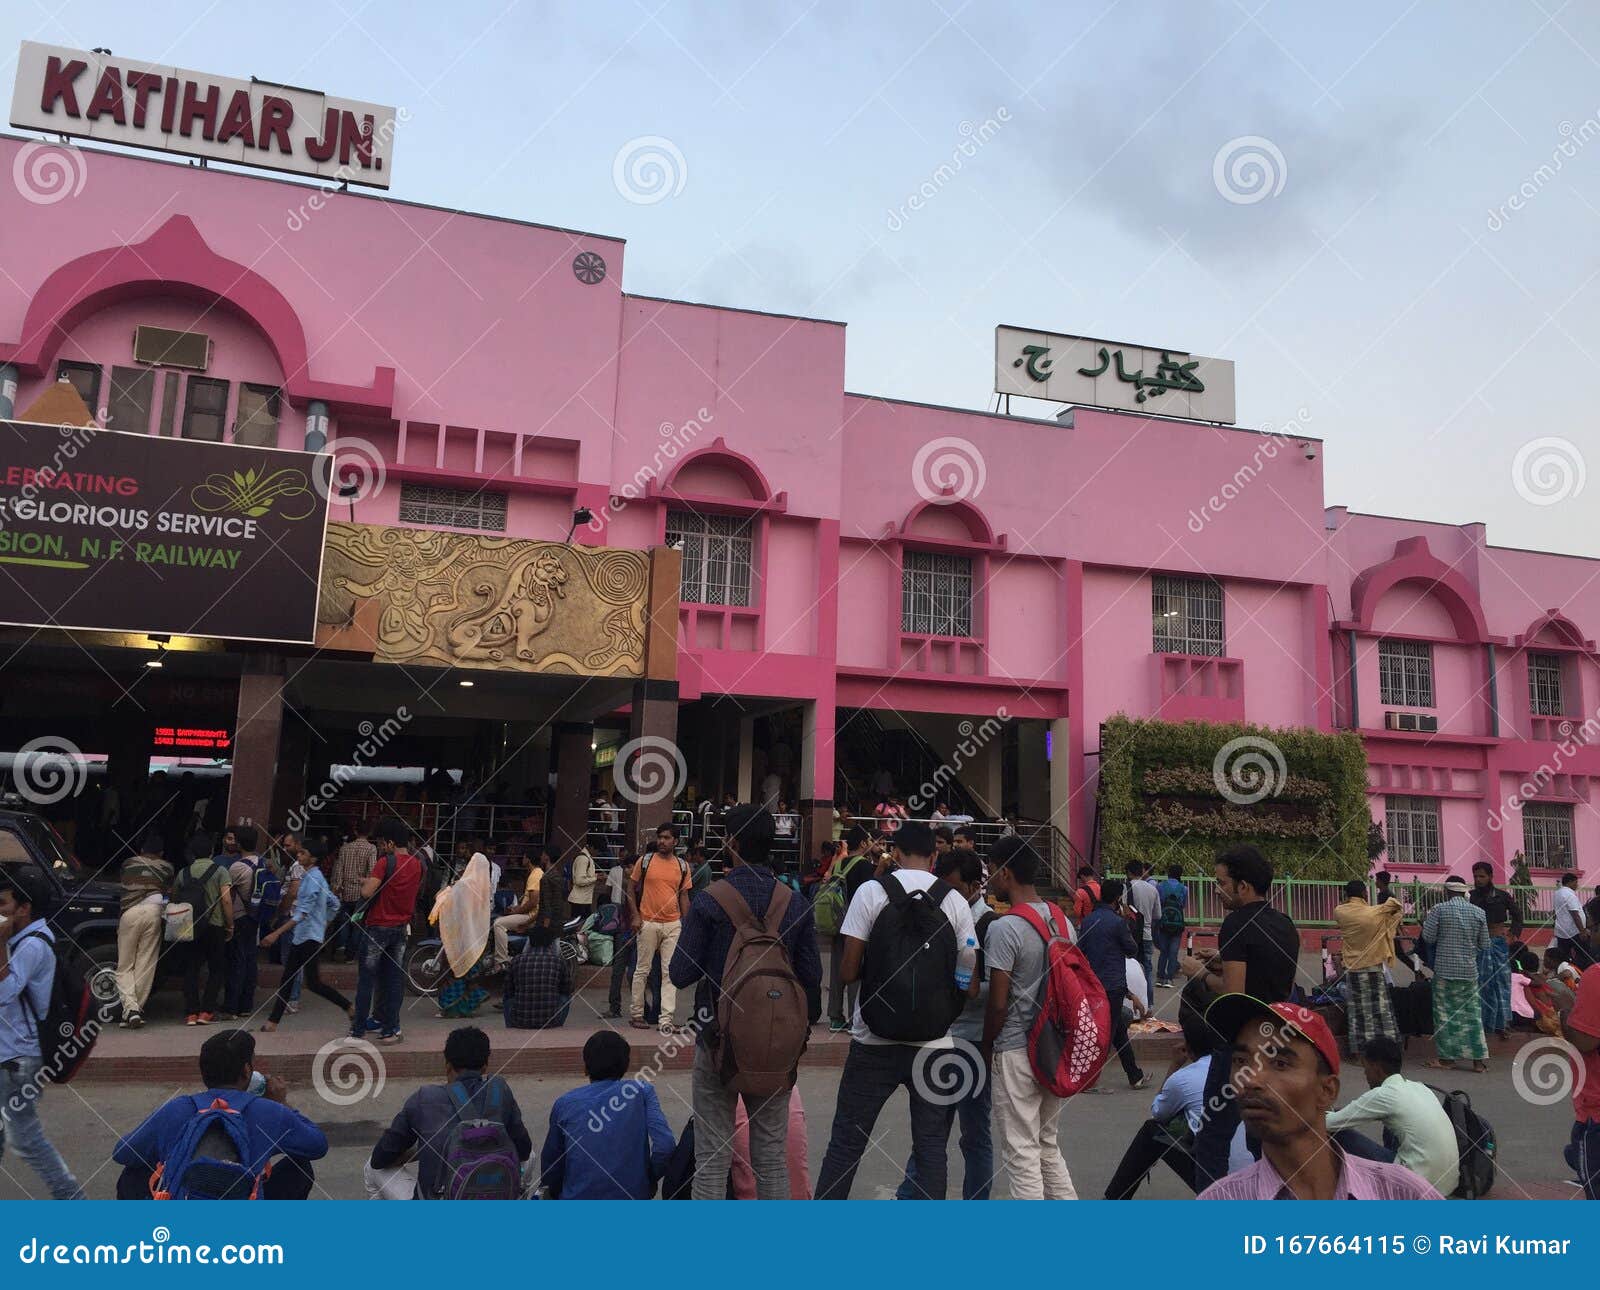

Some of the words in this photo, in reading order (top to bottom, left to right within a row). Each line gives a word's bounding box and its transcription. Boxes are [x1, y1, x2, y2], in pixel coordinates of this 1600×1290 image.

[41, 55, 294, 155] KATIHAR
[305, 107, 382, 170] JN.
[0, 466, 139, 496] EBRATING
[15, 499, 149, 530] GLORIOUS
[157, 511, 257, 540] SERVICE
[81, 536, 125, 561] N.F.
[136, 542, 242, 570] RAILWAY
